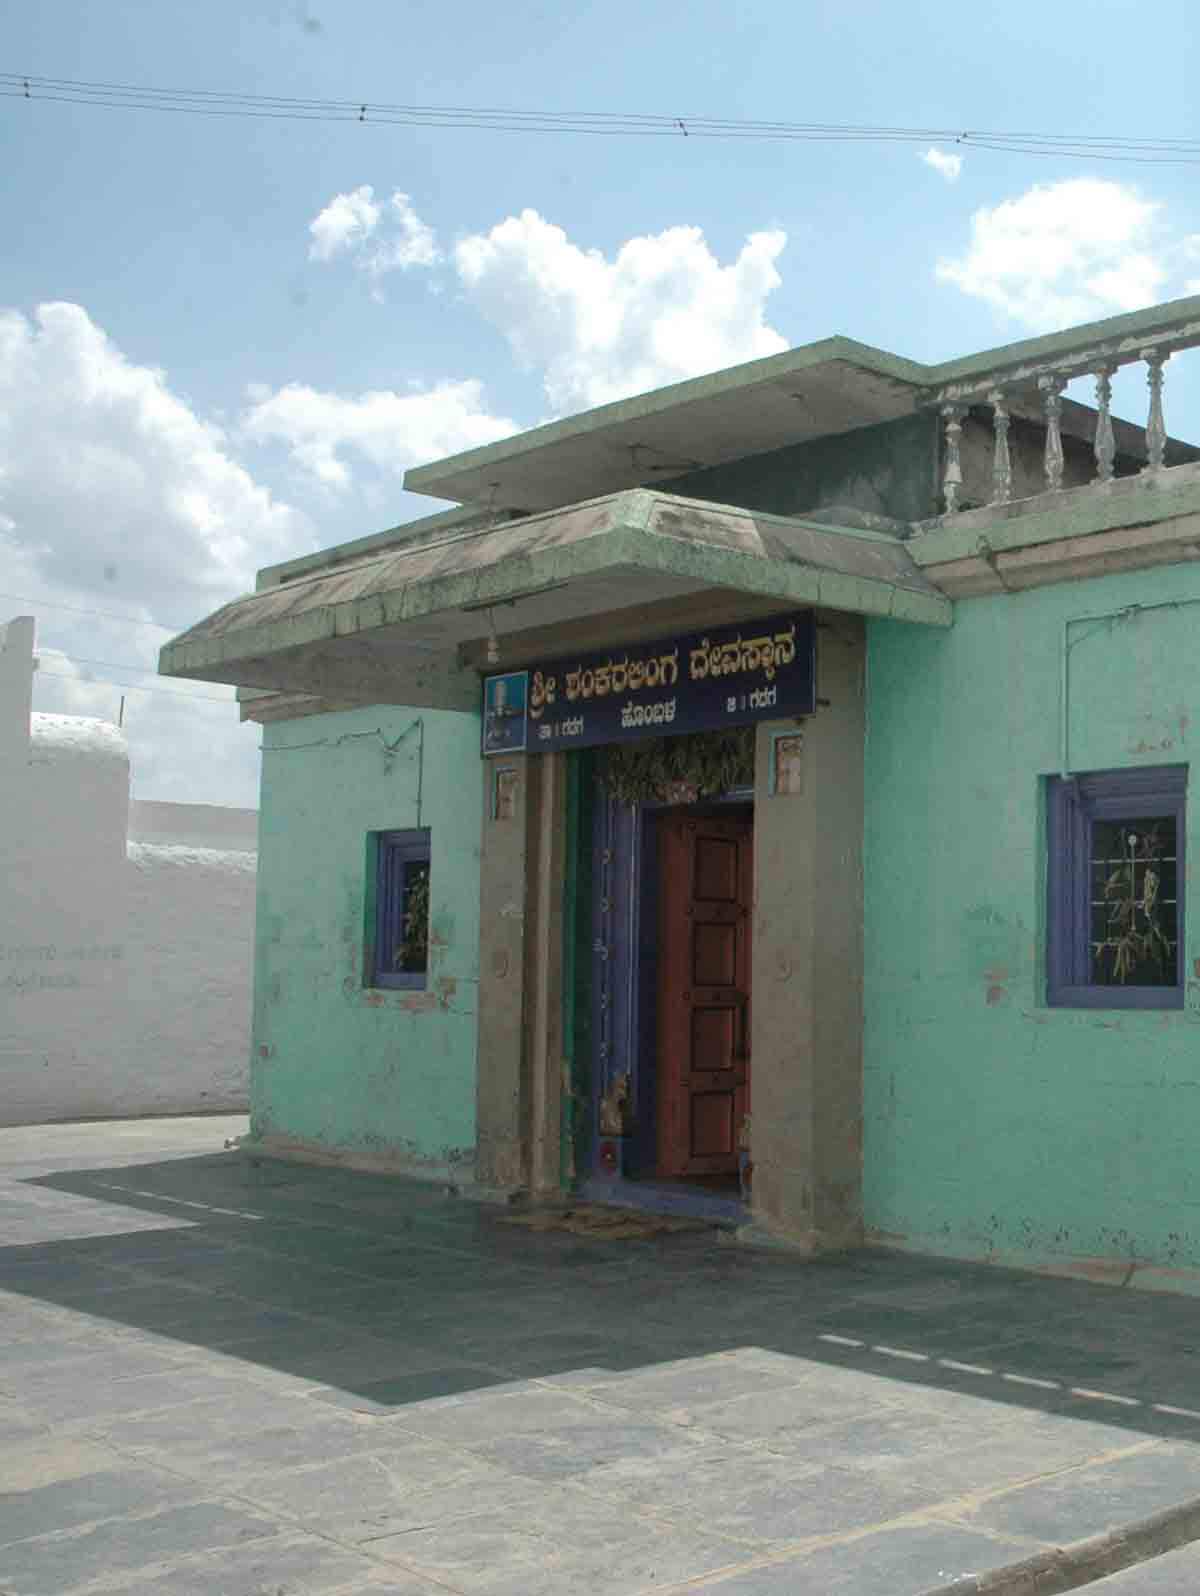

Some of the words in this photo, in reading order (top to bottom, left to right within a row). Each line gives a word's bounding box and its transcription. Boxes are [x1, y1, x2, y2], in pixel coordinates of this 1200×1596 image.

[529, 671, 556, 719] ಶ್ರೀ
[566, 647, 679, 700] ಶಂಕರಲಿಂಗ
[689, 624, 797, 680] ದೇವಸ್ಥಾನ
